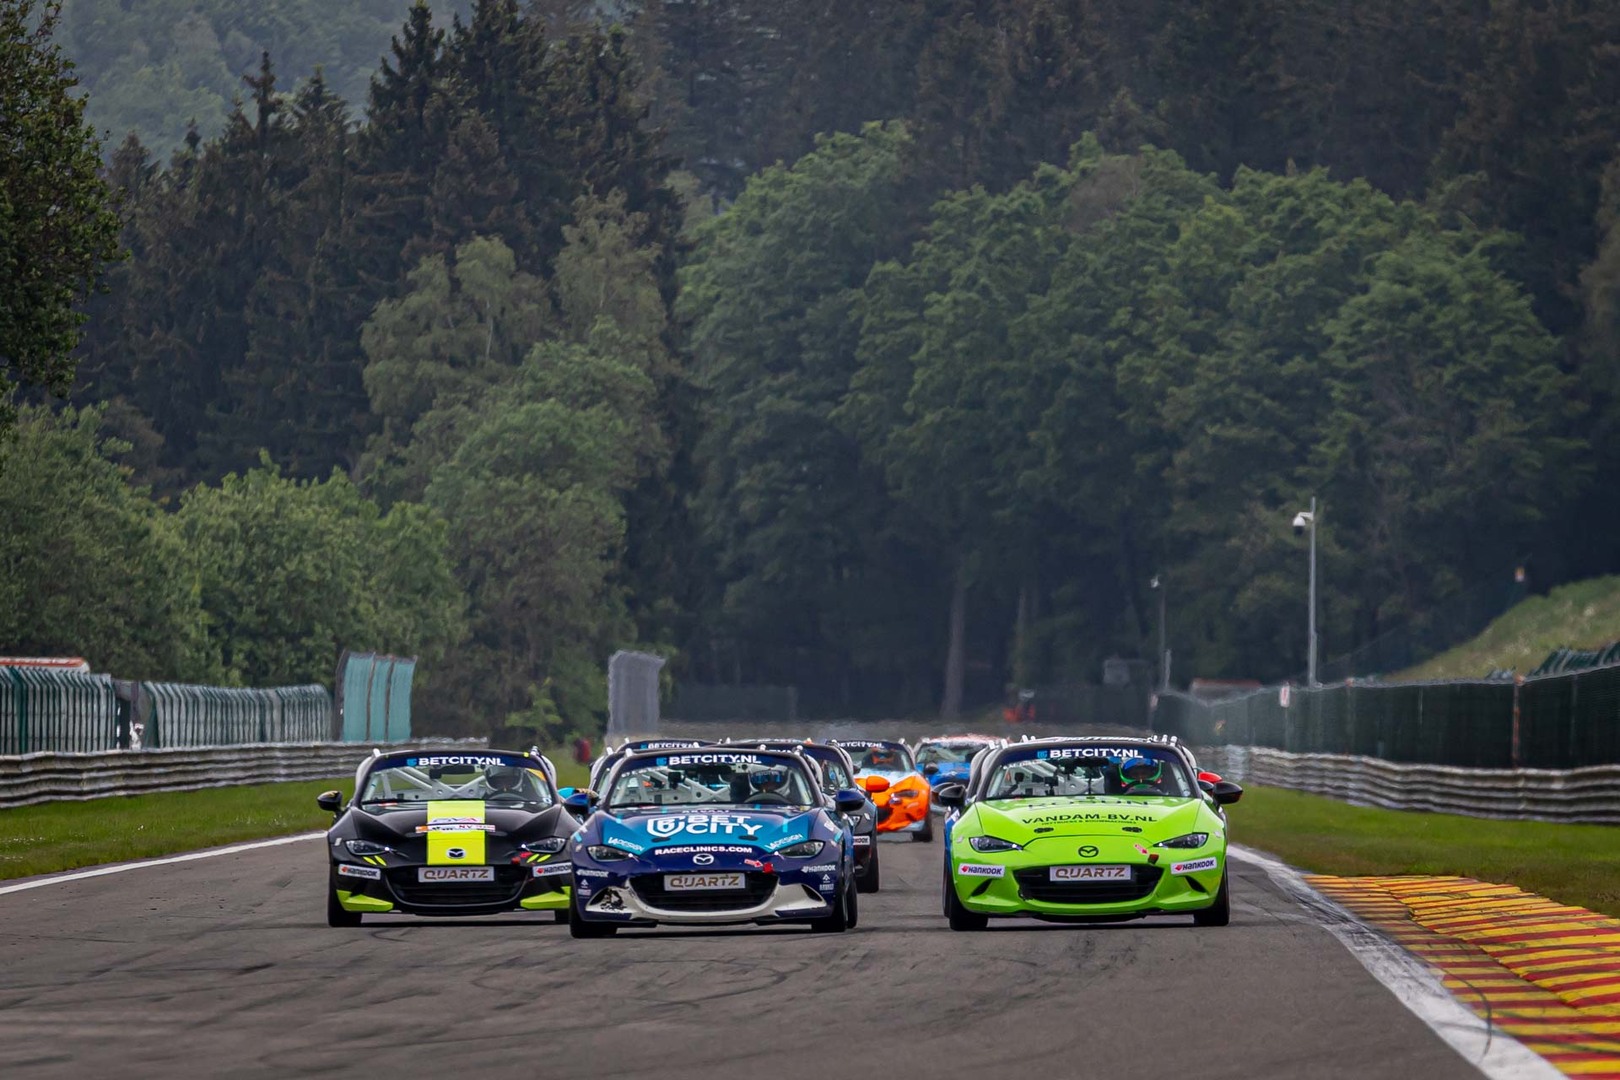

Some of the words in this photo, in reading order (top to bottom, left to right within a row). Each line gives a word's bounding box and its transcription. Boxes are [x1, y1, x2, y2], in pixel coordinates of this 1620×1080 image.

[1050, 748, 1144, 759] BETCITY.NL
[418, 756, 506, 767] BETCITY.NL
[668, 754, 762, 766] BETCITY.NL
[688, 814, 752, 824] BET
[1022, 813, 1158, 825] VANDAM-BV.NL
[685, 822, 763, 836] CITY
[654, 846, 753, 856] RACECLINICS.COM
[424, 868, 489, 881] QUARTZ
[1055, 867, 1128, 880] QUARTZ
[670, 874, 740, 888] QUARTZ
